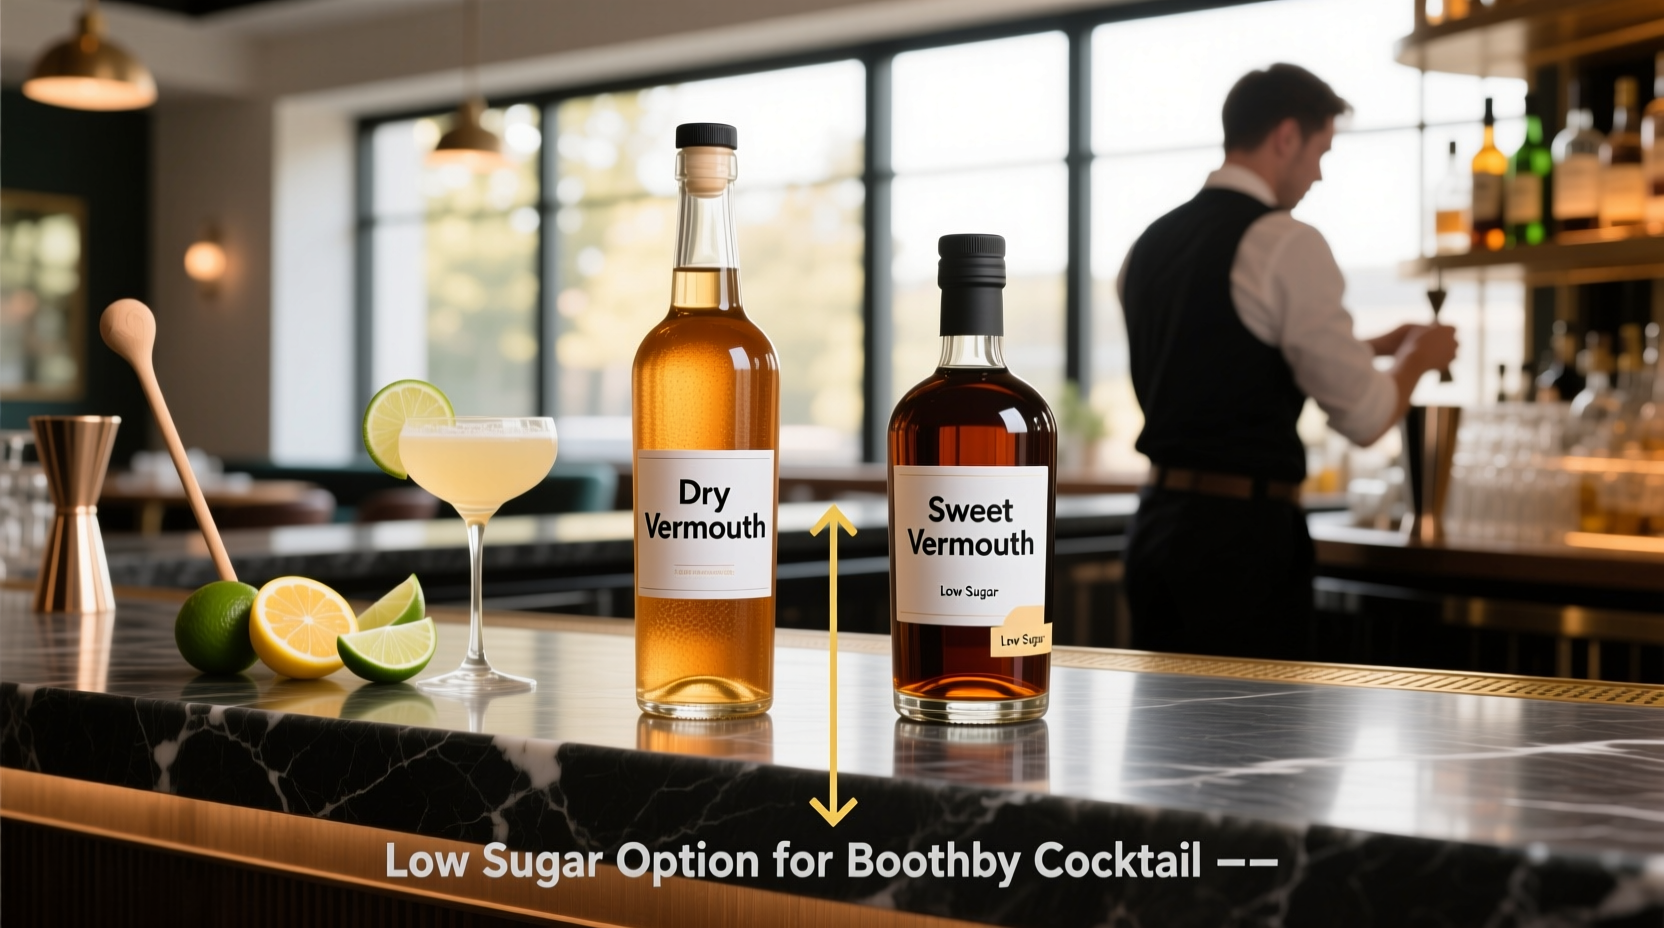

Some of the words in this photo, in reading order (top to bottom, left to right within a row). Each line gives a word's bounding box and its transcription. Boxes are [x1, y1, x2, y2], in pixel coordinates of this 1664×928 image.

[679, 478, 731, 513] Dry
[928, 495, 1014, 523] Sweet
[644, 512, 766, 539] Vermouth
[907, 528, 1034, 556] Vermouth
[940, 585, 962, 597] Low
[965, 585, 999, 600] Sugar
